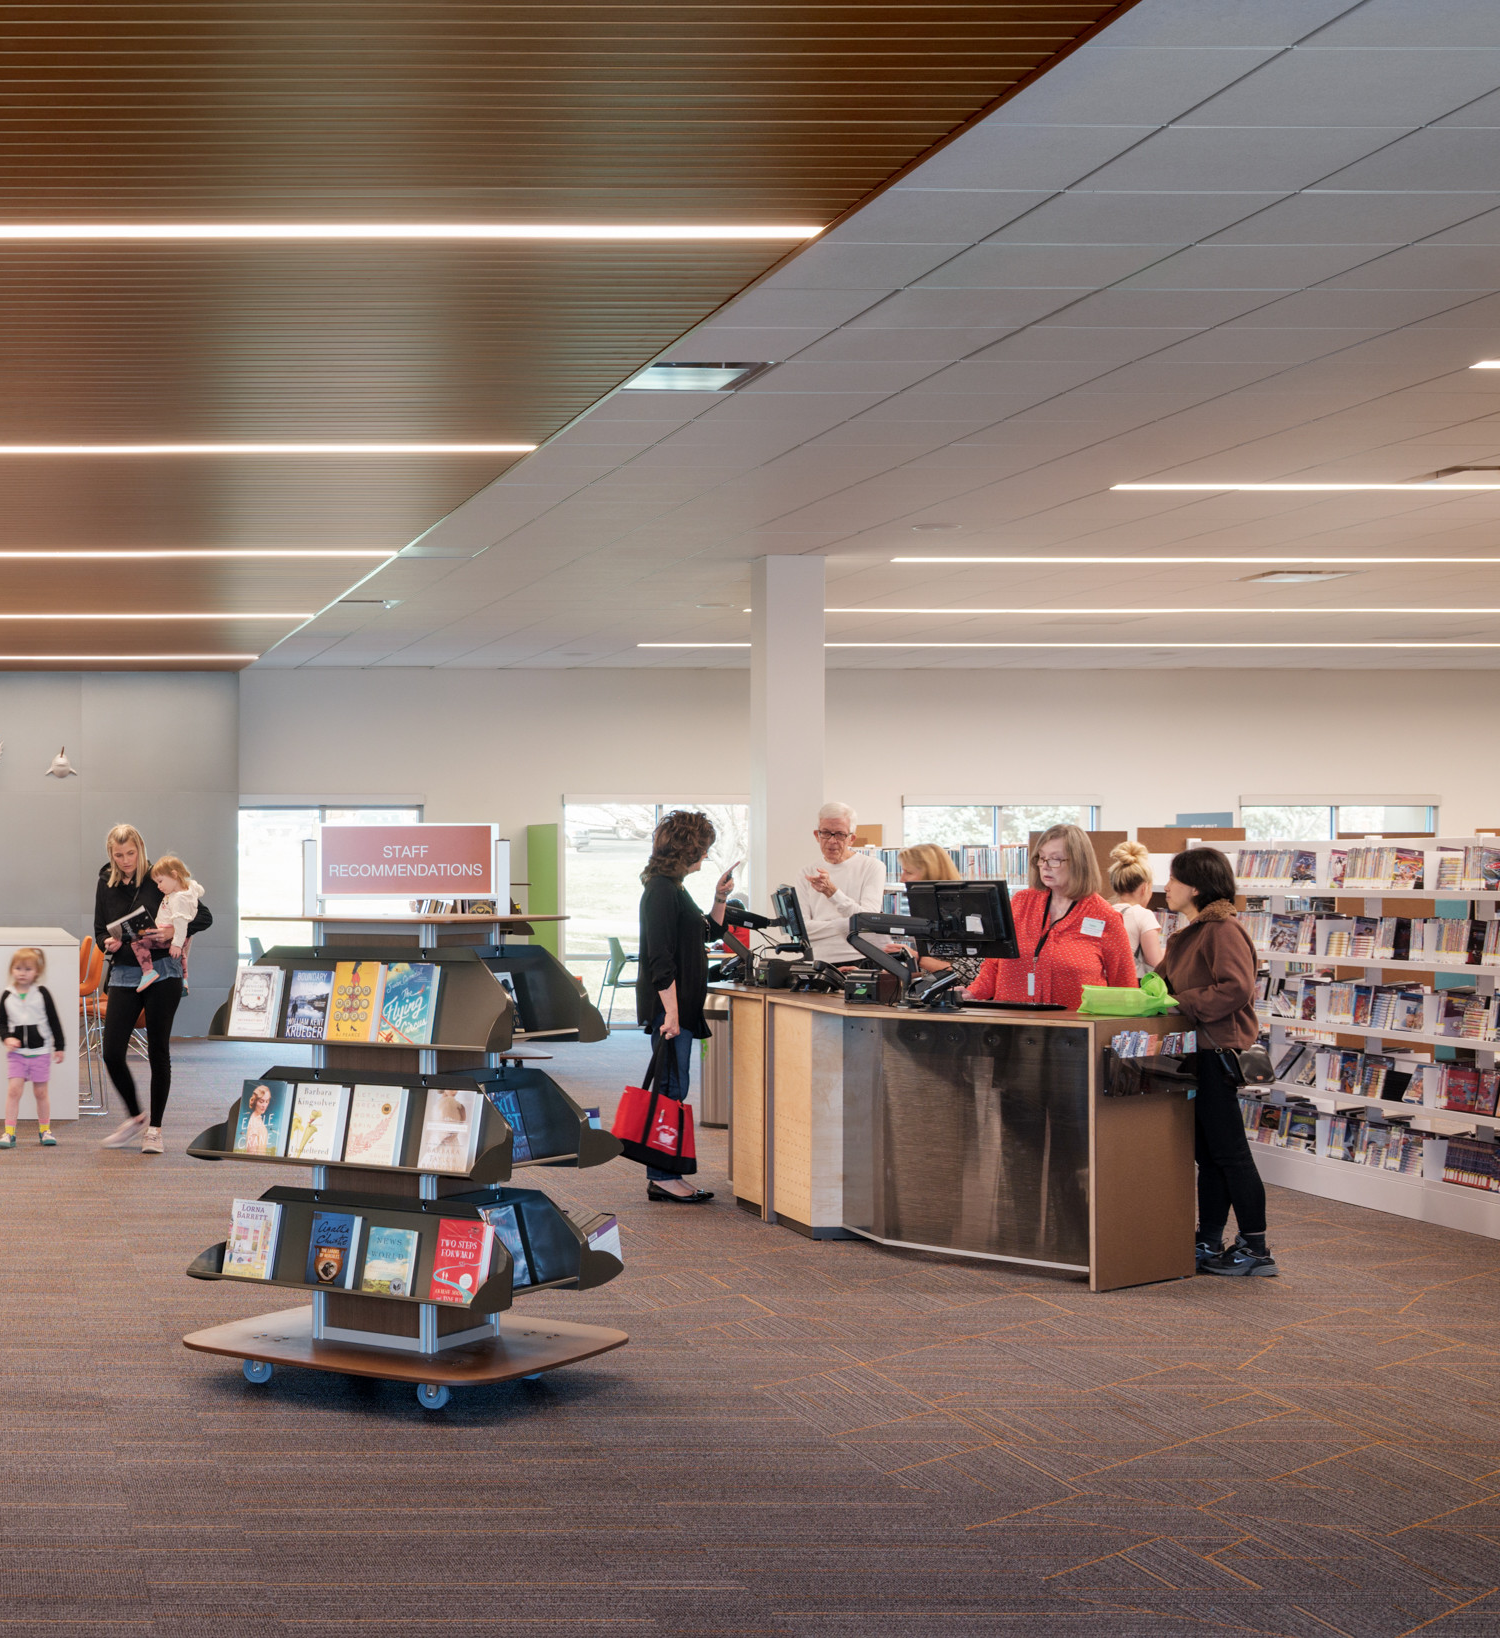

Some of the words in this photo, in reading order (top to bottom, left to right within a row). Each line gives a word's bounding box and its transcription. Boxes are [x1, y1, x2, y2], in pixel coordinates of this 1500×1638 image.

[383, 845, 429, 858] STAFF
[329, 864, 483, 877] RECOMMENDATIONS
[297, 973, 328, 982] BOUNDARY
[383, 996, 427, 1027] Flying
[287, 1018, 309, 1027] WILLIAM
[309, 1018, 324, 1026] KENT
[399, 1018, 428, 1034] Circus
[285, 1026, 323, 1038] KRUEGER
[304, 1087, 332, 1096] Barbara
[298, 1098, 336, 1107] Kingsolver
[237, 1133, 272, 1149] CRANE
[241, 1203, 265, 1213] LORNA
[236, 1211, 268, 1221] BARRETT
[318, 1220, 349, 1236] Agatha
[316, 1235, 348, 1246] Christie
[376, 1237, 402, 1246] NEWS
[441, 1239, 456, 1247] TWO
[457, 1240, 478, 1250] STEPS
[371, 1251, 404, 1260] WORLD
[440, 1248, 474, 1259] FORWARD
